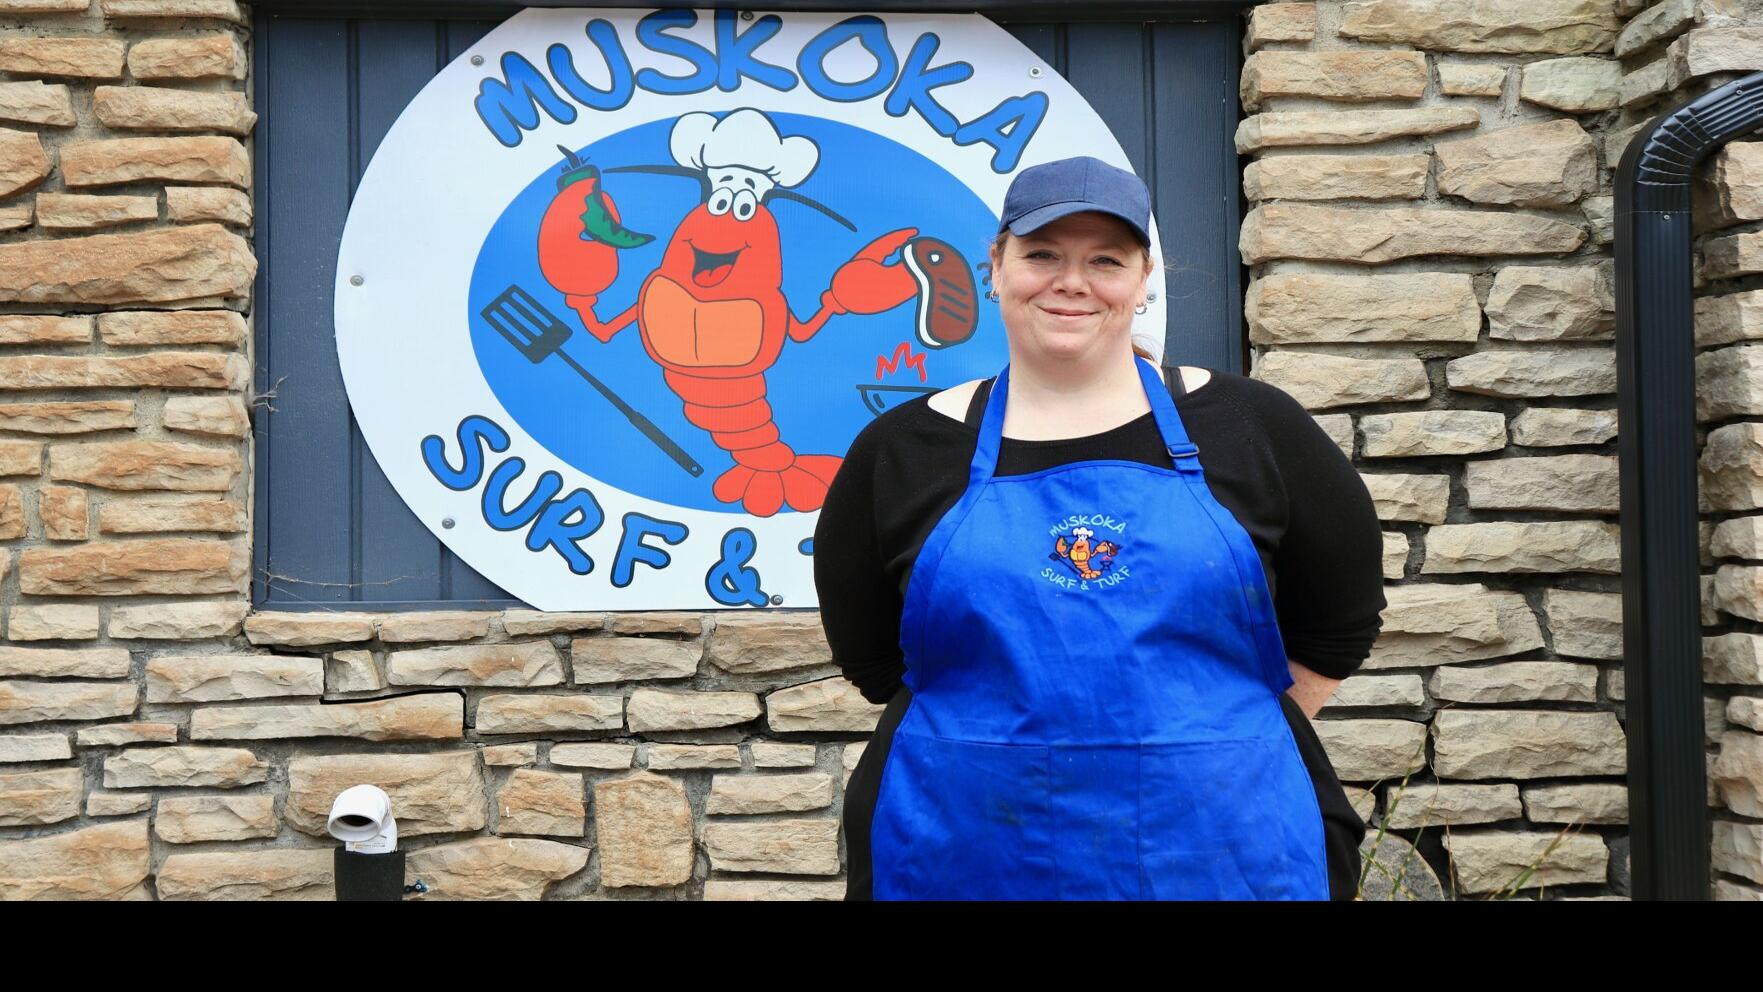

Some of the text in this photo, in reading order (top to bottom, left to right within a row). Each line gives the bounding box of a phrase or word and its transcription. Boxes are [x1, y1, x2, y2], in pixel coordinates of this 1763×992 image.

[474, 9, 1049, 173] MUSKOKA
[421, 414, 770, 607] SURF &
[1049, 514, 1126, 536] MUSKOKA
[1041, 565, 1130, 590] SURF & TURF
